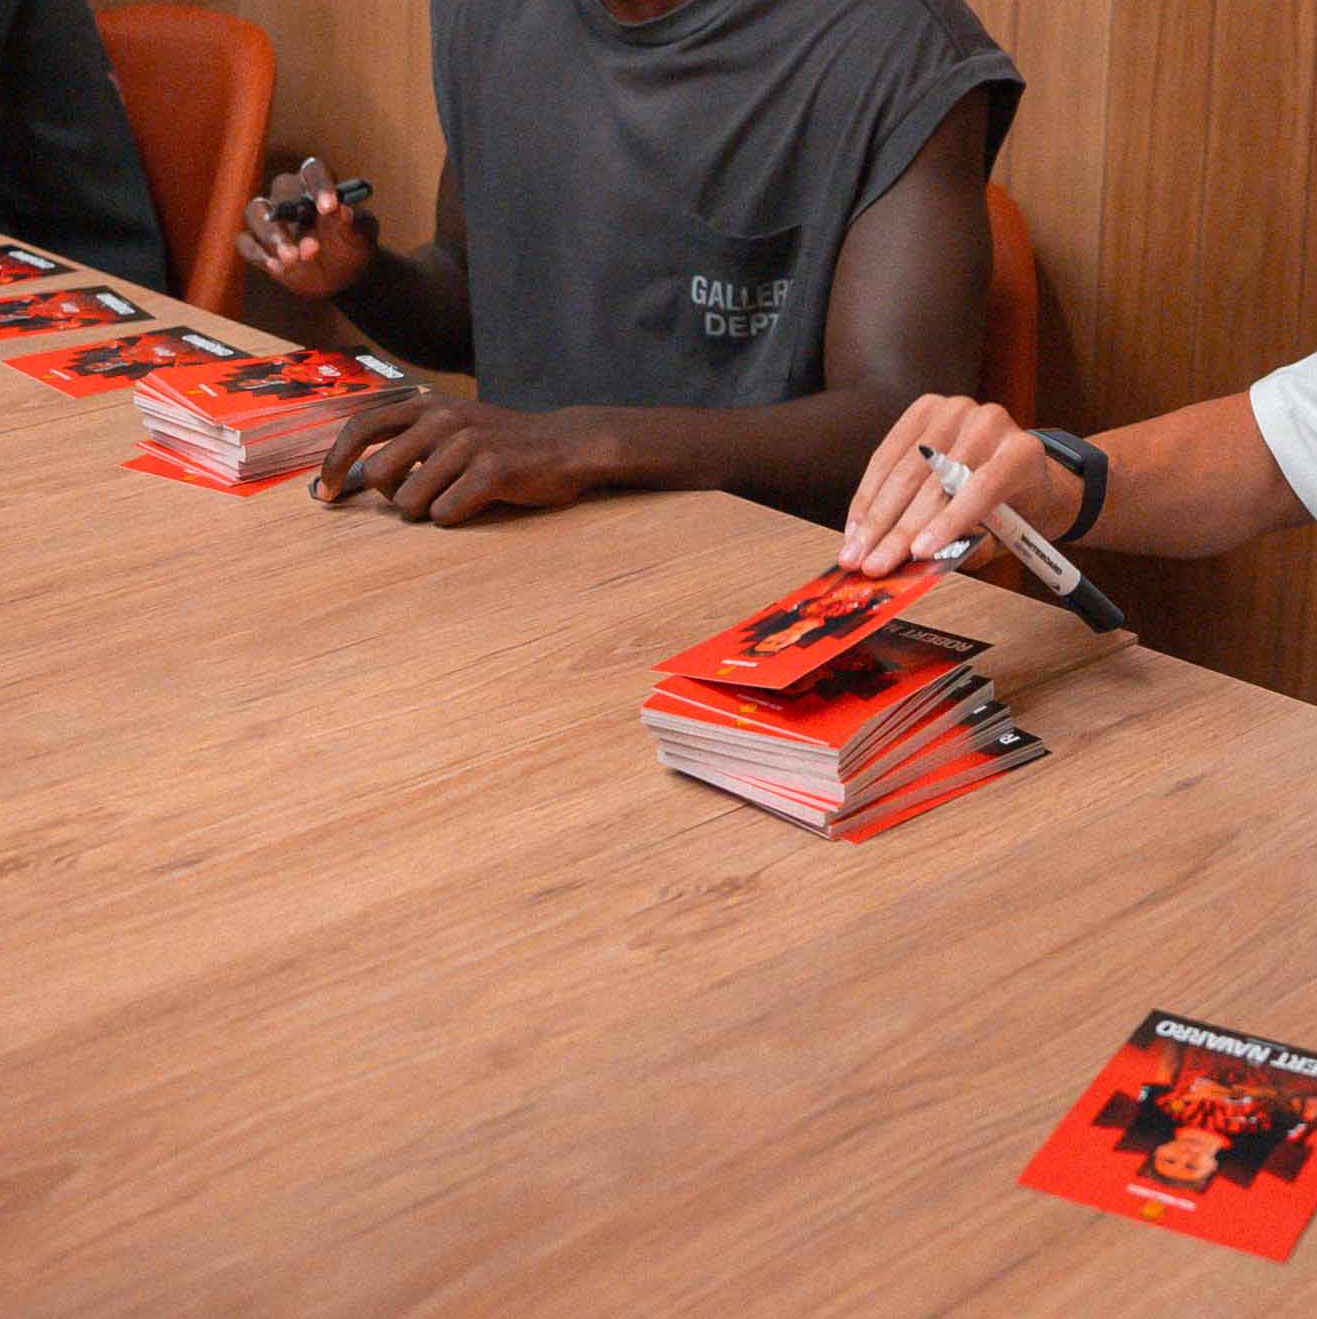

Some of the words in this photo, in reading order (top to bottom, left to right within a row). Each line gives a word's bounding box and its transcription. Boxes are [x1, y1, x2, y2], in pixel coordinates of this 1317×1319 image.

[690, 275, 793, 312] GALLER
[898, 629, 974, 653] ROBERT
[1154, 1019, 1271, 1066] NAVARRO
